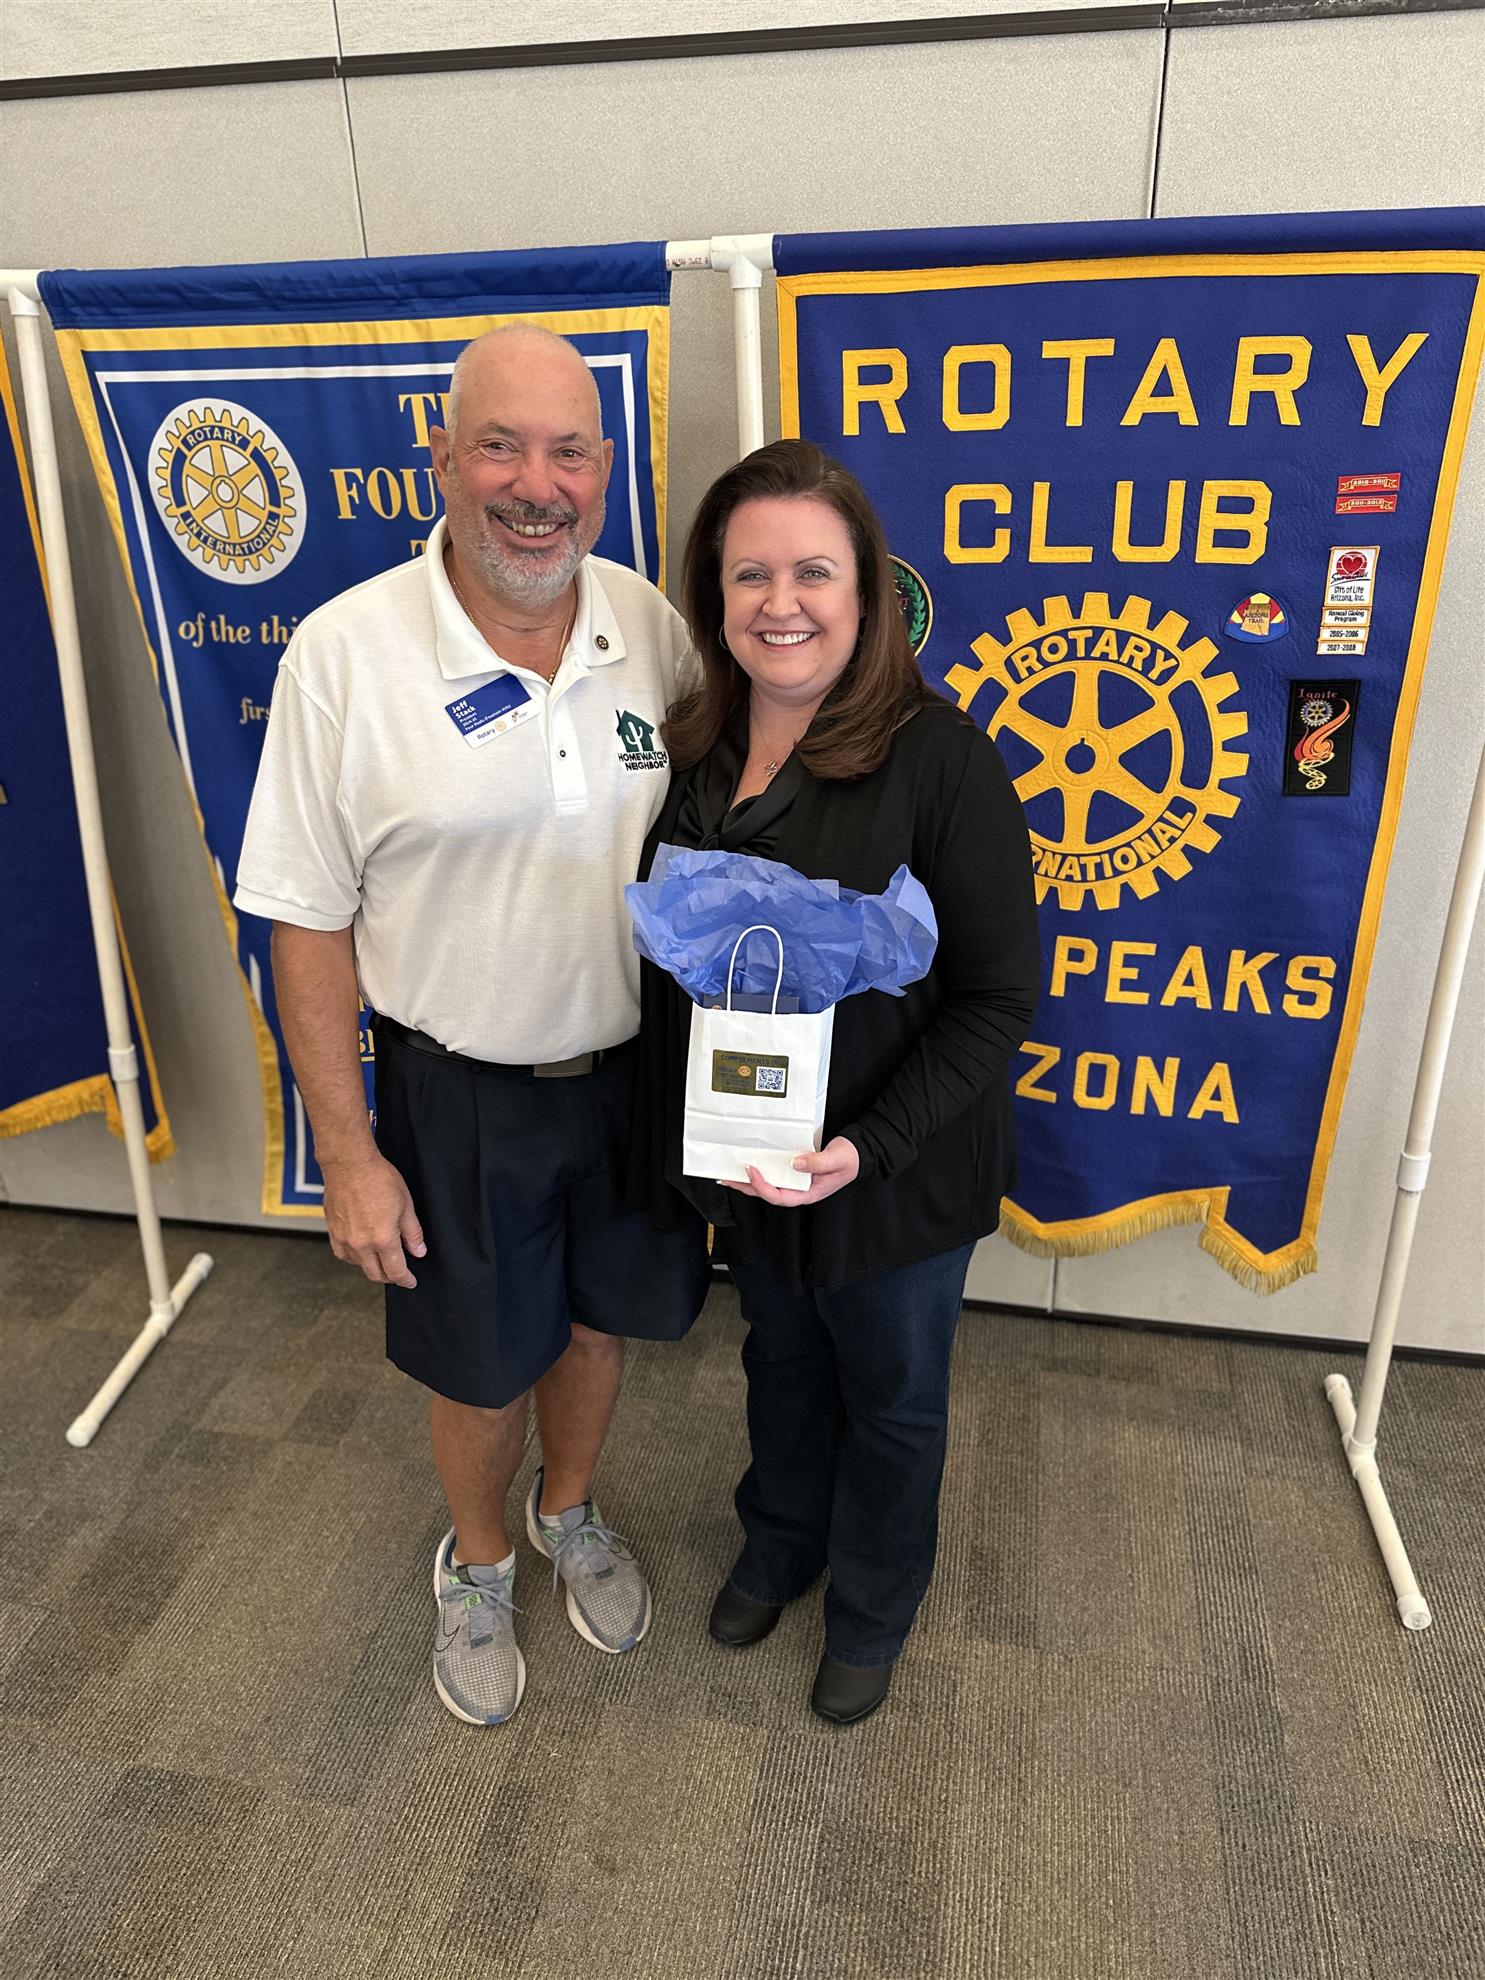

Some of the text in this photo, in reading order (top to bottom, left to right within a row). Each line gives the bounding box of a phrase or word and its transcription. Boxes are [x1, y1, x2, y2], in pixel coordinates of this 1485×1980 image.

[842, 333, 1429, 435] ROTARY
[186, 427, 243, 447] ROTARY
[185, 514, 279, 556] INTERNATIONAL
[944, 480, 1272, 564] CLUB
[178, 611, 206, 648] of
[210, 614, 251, 644] the
[1011, 629, 1178, 680] ROTARY
[451, 700, 468, 714] Jeff
[1298, 688, 1338, 700] Ignite
[455, 705, 476, 719] Stack
[476, 728, 496, 740] Rotary
[617, 751, 668, 762] HOMEWATCH
[1050, 935, 1336, 1020] PEAKS
